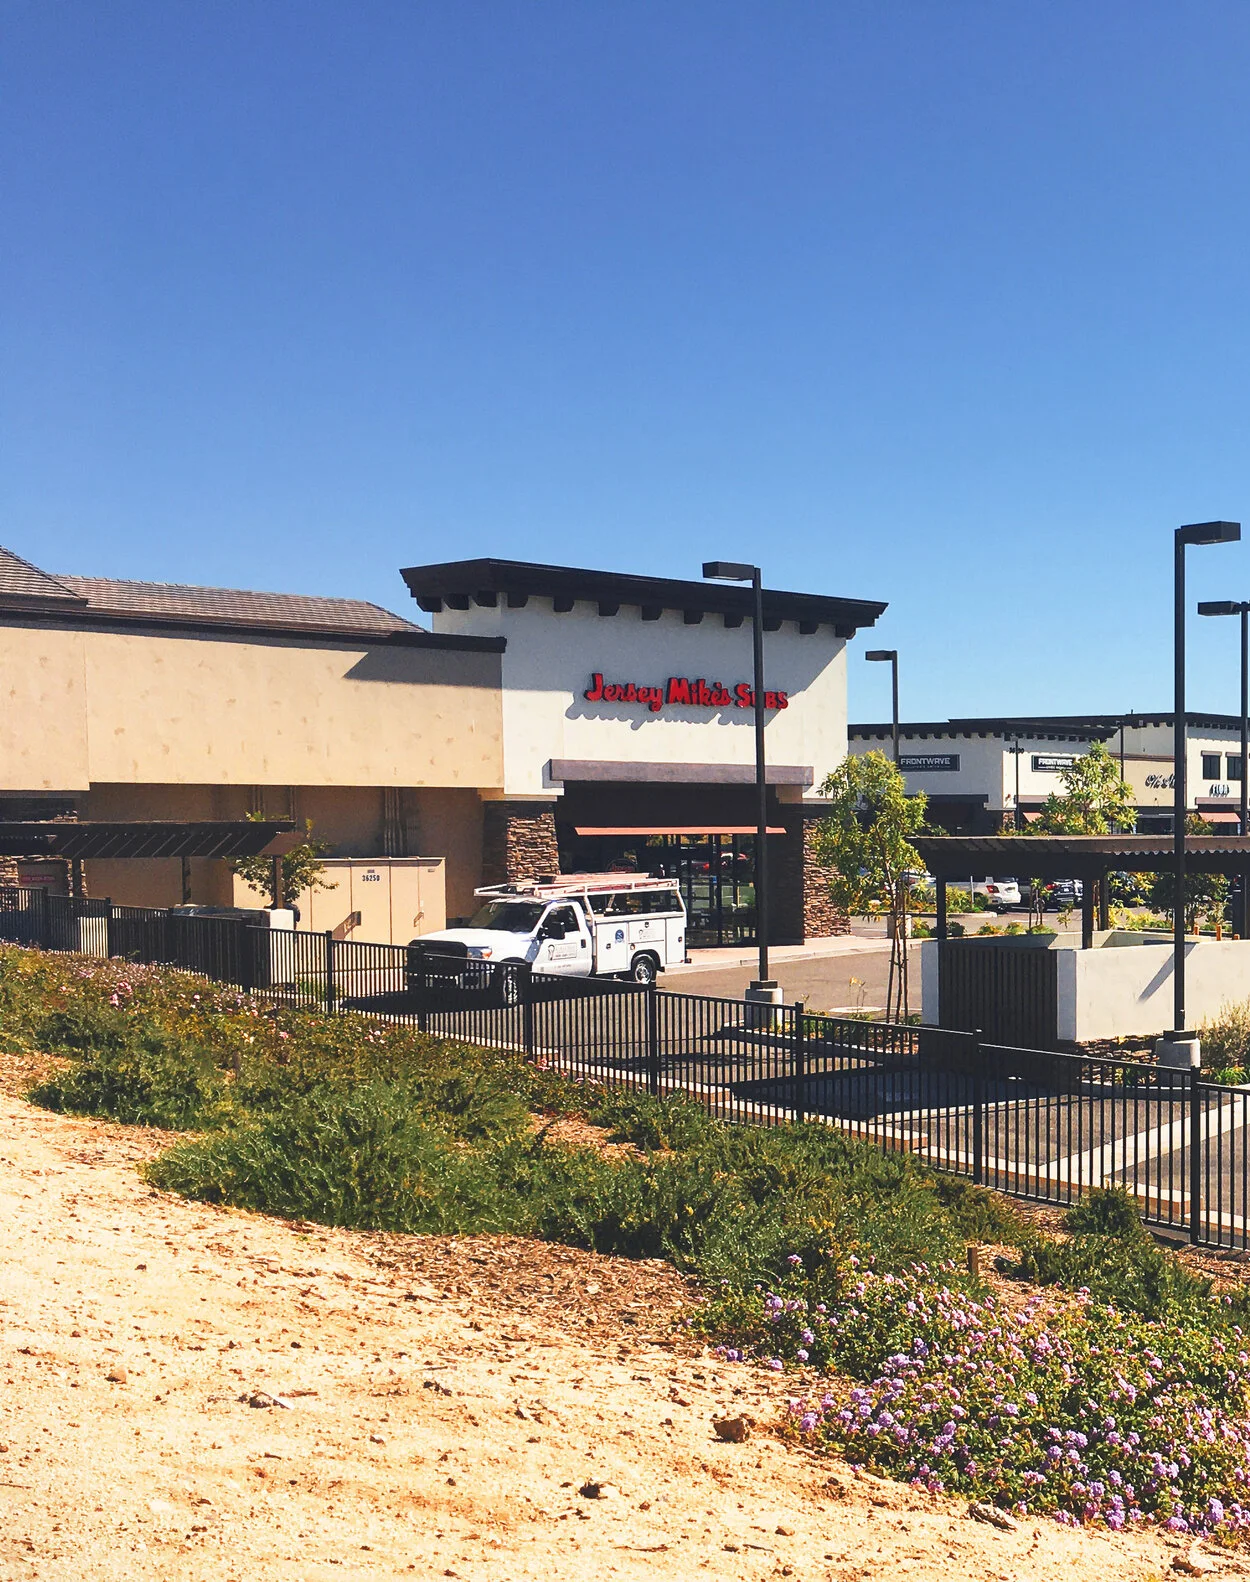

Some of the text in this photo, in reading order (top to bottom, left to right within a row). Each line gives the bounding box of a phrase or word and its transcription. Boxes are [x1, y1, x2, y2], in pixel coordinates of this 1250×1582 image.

[584, 673, 663, 712] Jersey
[665, 677, 733, 707] Mike's
[901, 757, 950, 765] FRONTWAVE
